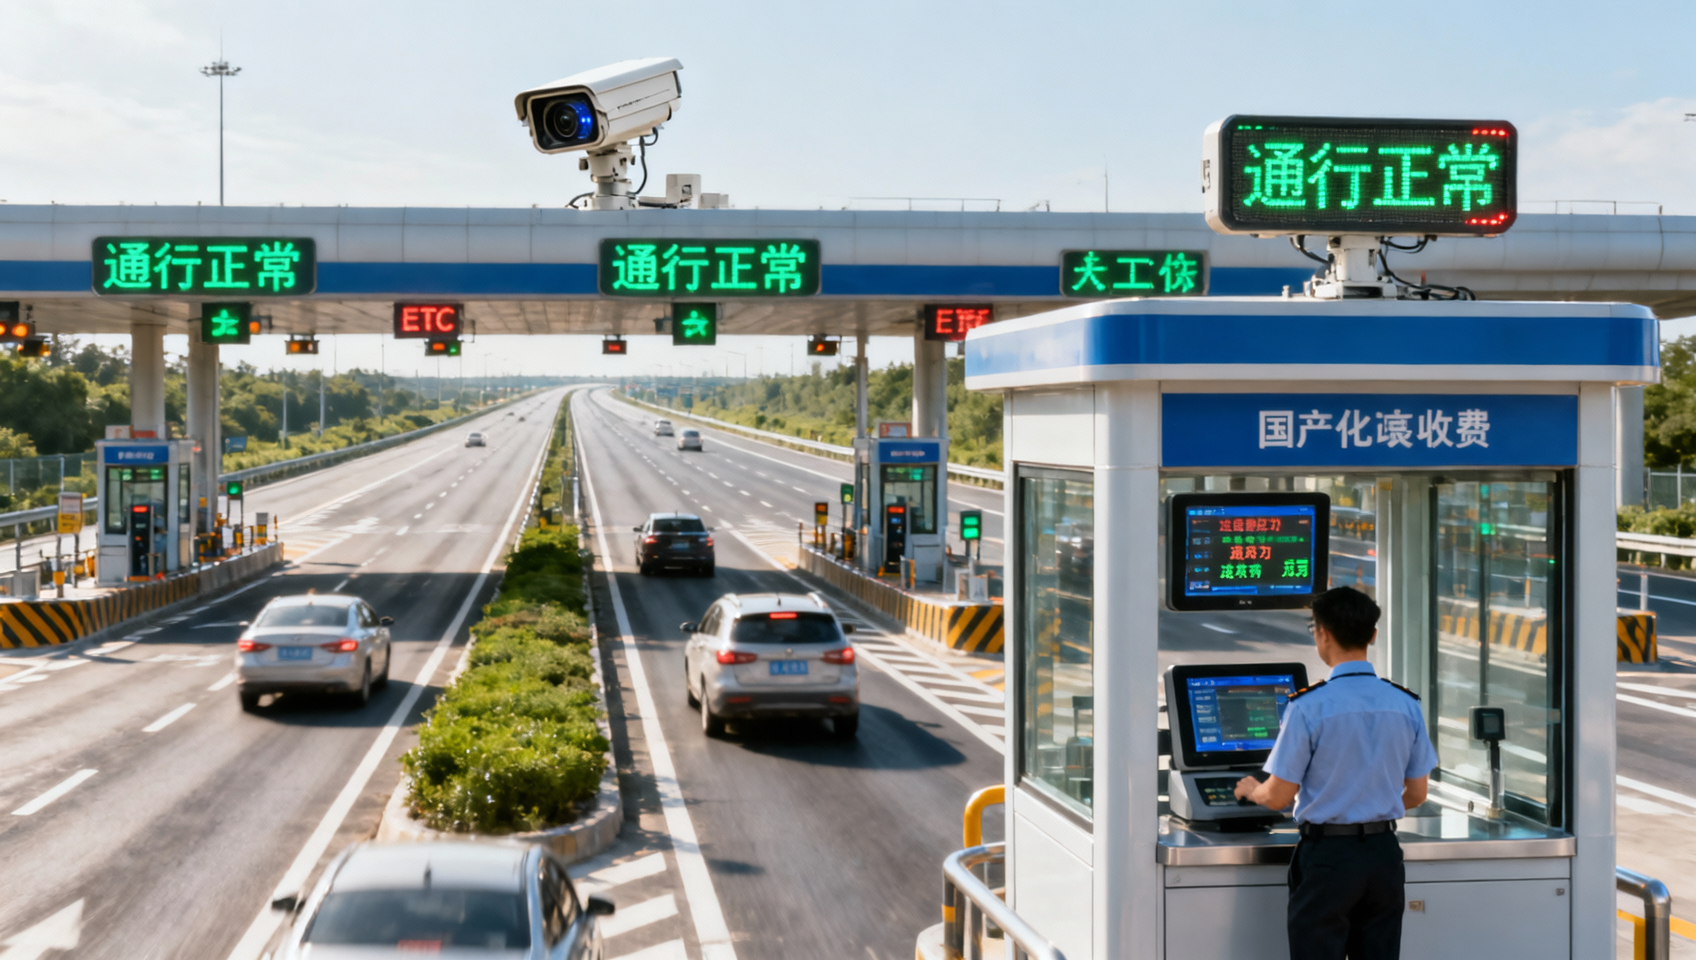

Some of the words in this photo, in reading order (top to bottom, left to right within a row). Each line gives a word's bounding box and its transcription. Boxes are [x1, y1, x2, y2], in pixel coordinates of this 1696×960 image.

[1242, 142, 1500, 212] 通行正常
[103, 241, 301, 292] 通行正常
[611, 243, 807, 293] 通行正常
[402, 306, 455, 332] ETC
